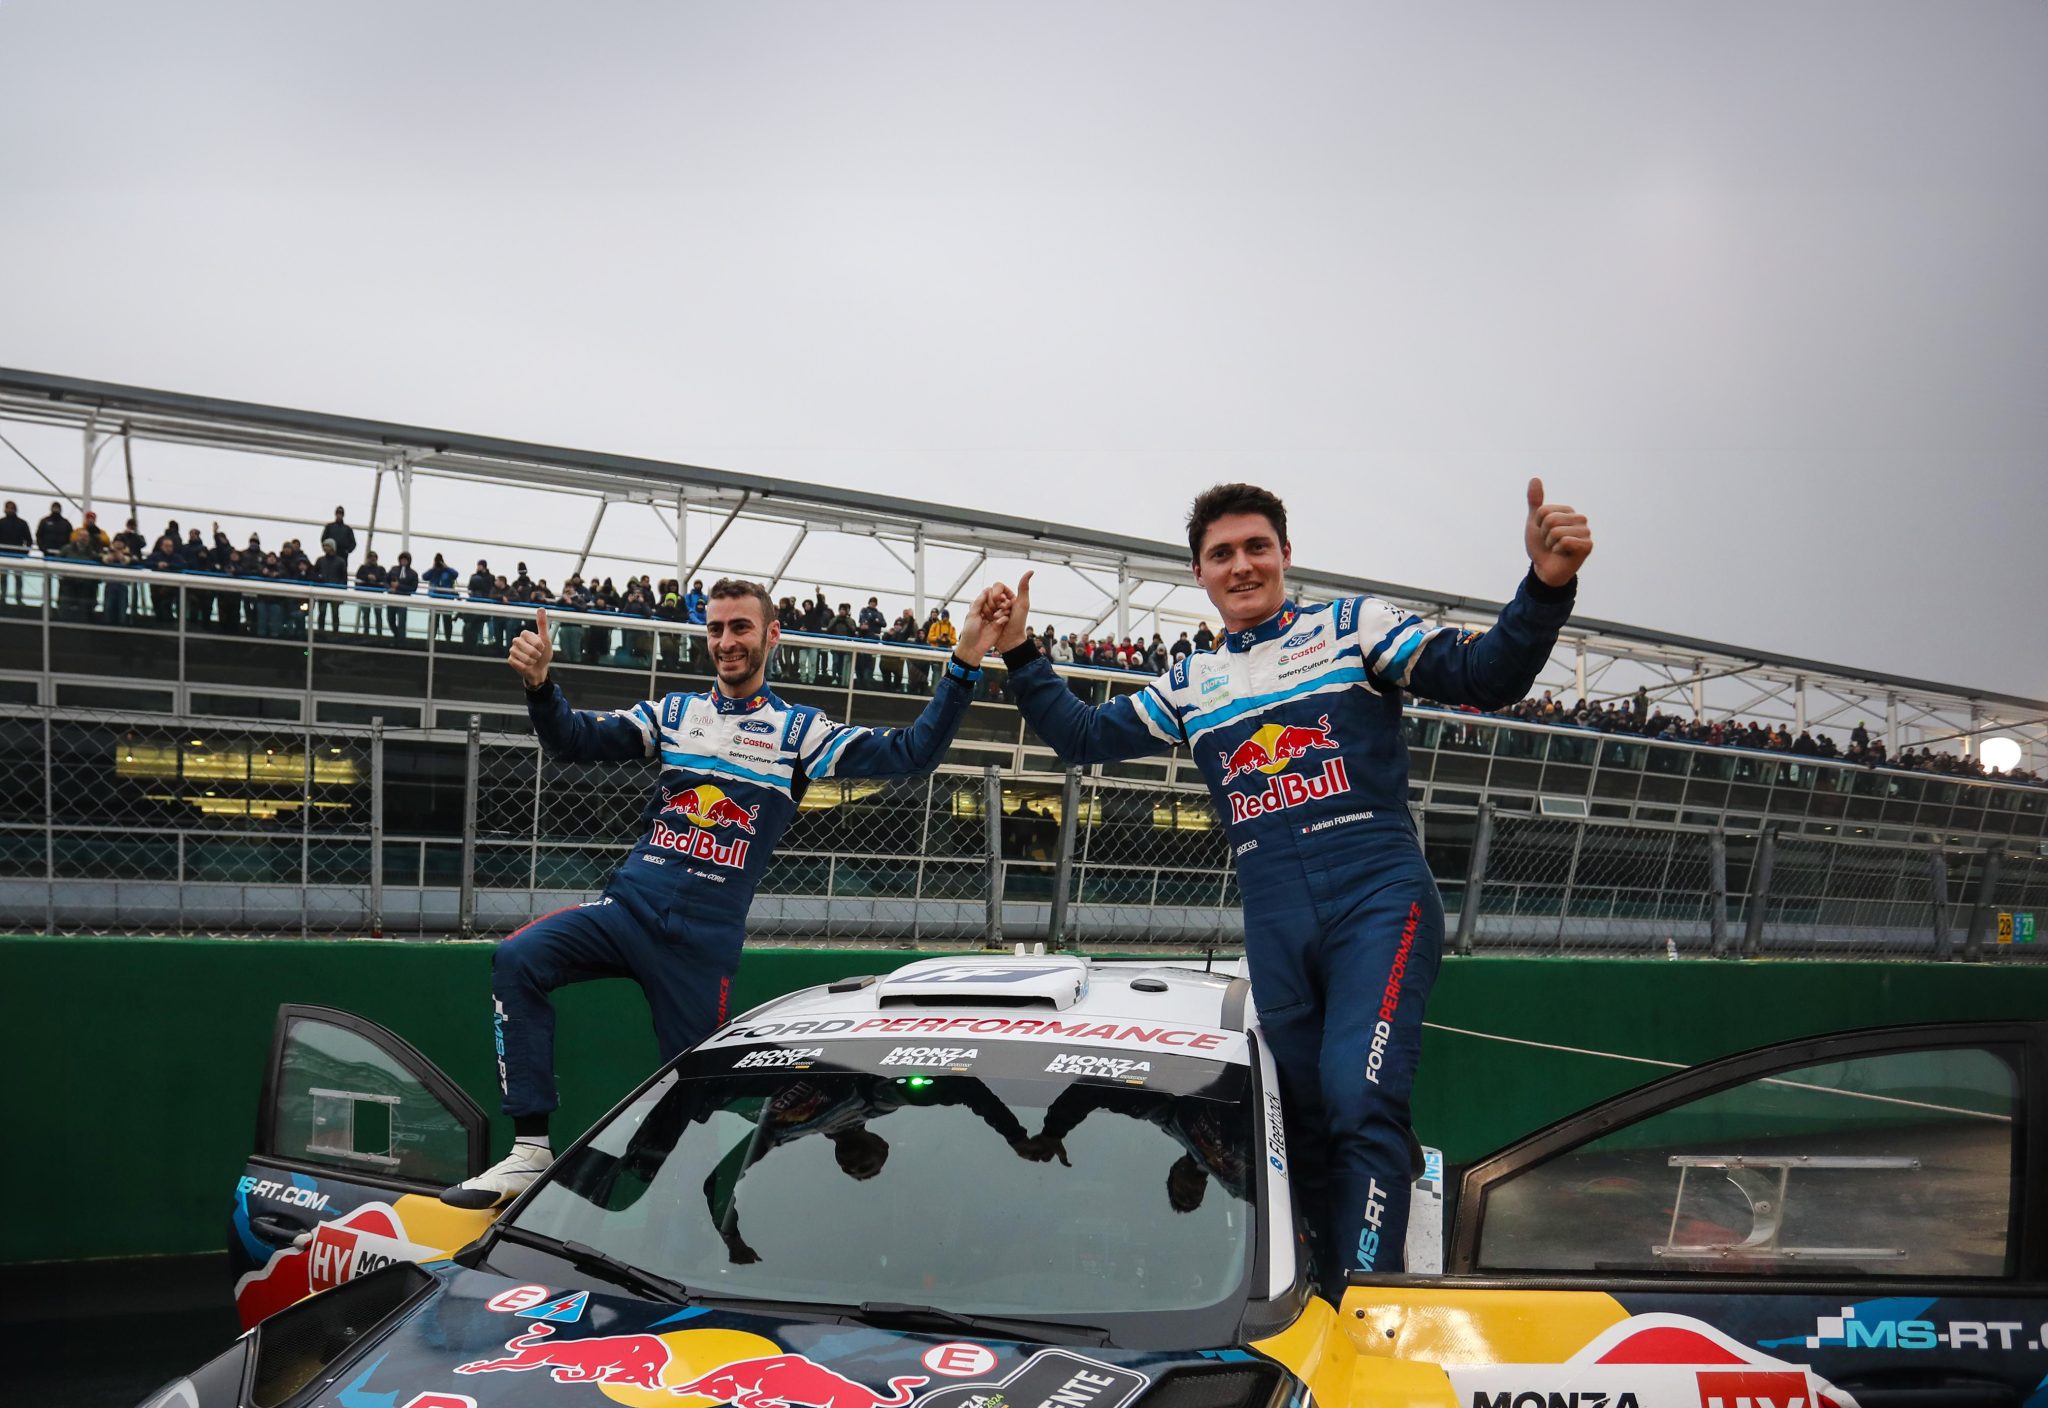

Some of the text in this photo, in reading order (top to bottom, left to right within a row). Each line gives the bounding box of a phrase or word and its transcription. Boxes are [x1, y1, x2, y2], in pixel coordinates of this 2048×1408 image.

[1290, 640, 1326, 661] Castrol
[1278, 658, 1329, 680] SafetyCulture
[744, 721, 769, 733] Ford
[787, 712, 806, 746] sparco
[742, 737, 774, 750] Castrol
[728, 750, 772, 764] SafetyCulture
[1228, 756, 1351, 825] Red Bull
[1311, 810, 1374, 832] Adrien FOURMAUX
[650, 819, 750, 869] Red Bull
[1236, 839, 1258, 856] sparco
[642, 853, 665, 866] sparco
[1379, 901, 1422, 1021] PERFORMANCE
[713, 1017, 1229, 1050] FORD PERFORMANCE
[731, 1055, 804, 1069] RALLY
[742, 1047, 824, 1060] MONZA
[878, 1055, 957, 1067] RALLY
[891, 1046, 979, 1059] MONZA
[1052, 1052, 1151, 1073] MONZA
[1366, 1020, 1391, 1085] FORD
[1044, 1062, 1132, 1079] RALLY
[313, 1241, 352, 1284] HY
[1846, 1320, 2048, 1350] MS-RT.
